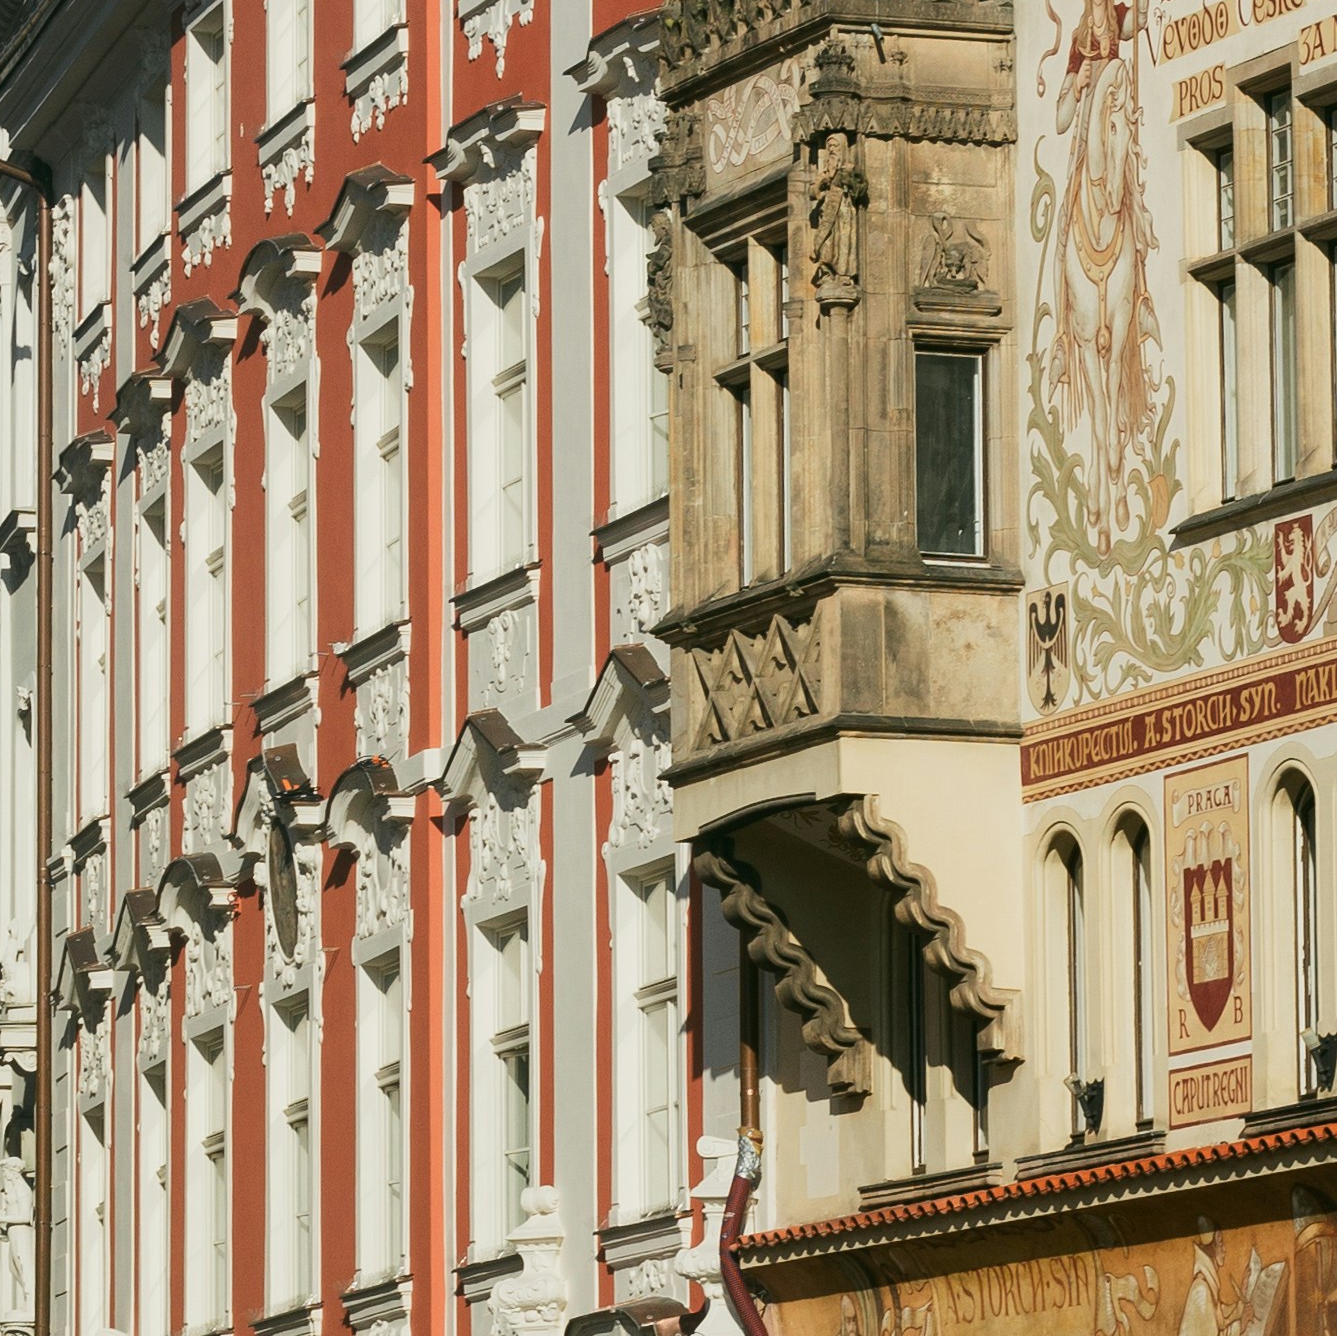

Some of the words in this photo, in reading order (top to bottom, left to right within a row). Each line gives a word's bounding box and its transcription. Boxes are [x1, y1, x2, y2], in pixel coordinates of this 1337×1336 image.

[1178, 63, 1224, 117] PROS
[1179, 1008, 1190, 1040] R
[1233, 996, 1243, 1025] B
[1173, 1072, 1212, 1115] CAPUT
[1213, 1065, 1248, 1109] REGNI
